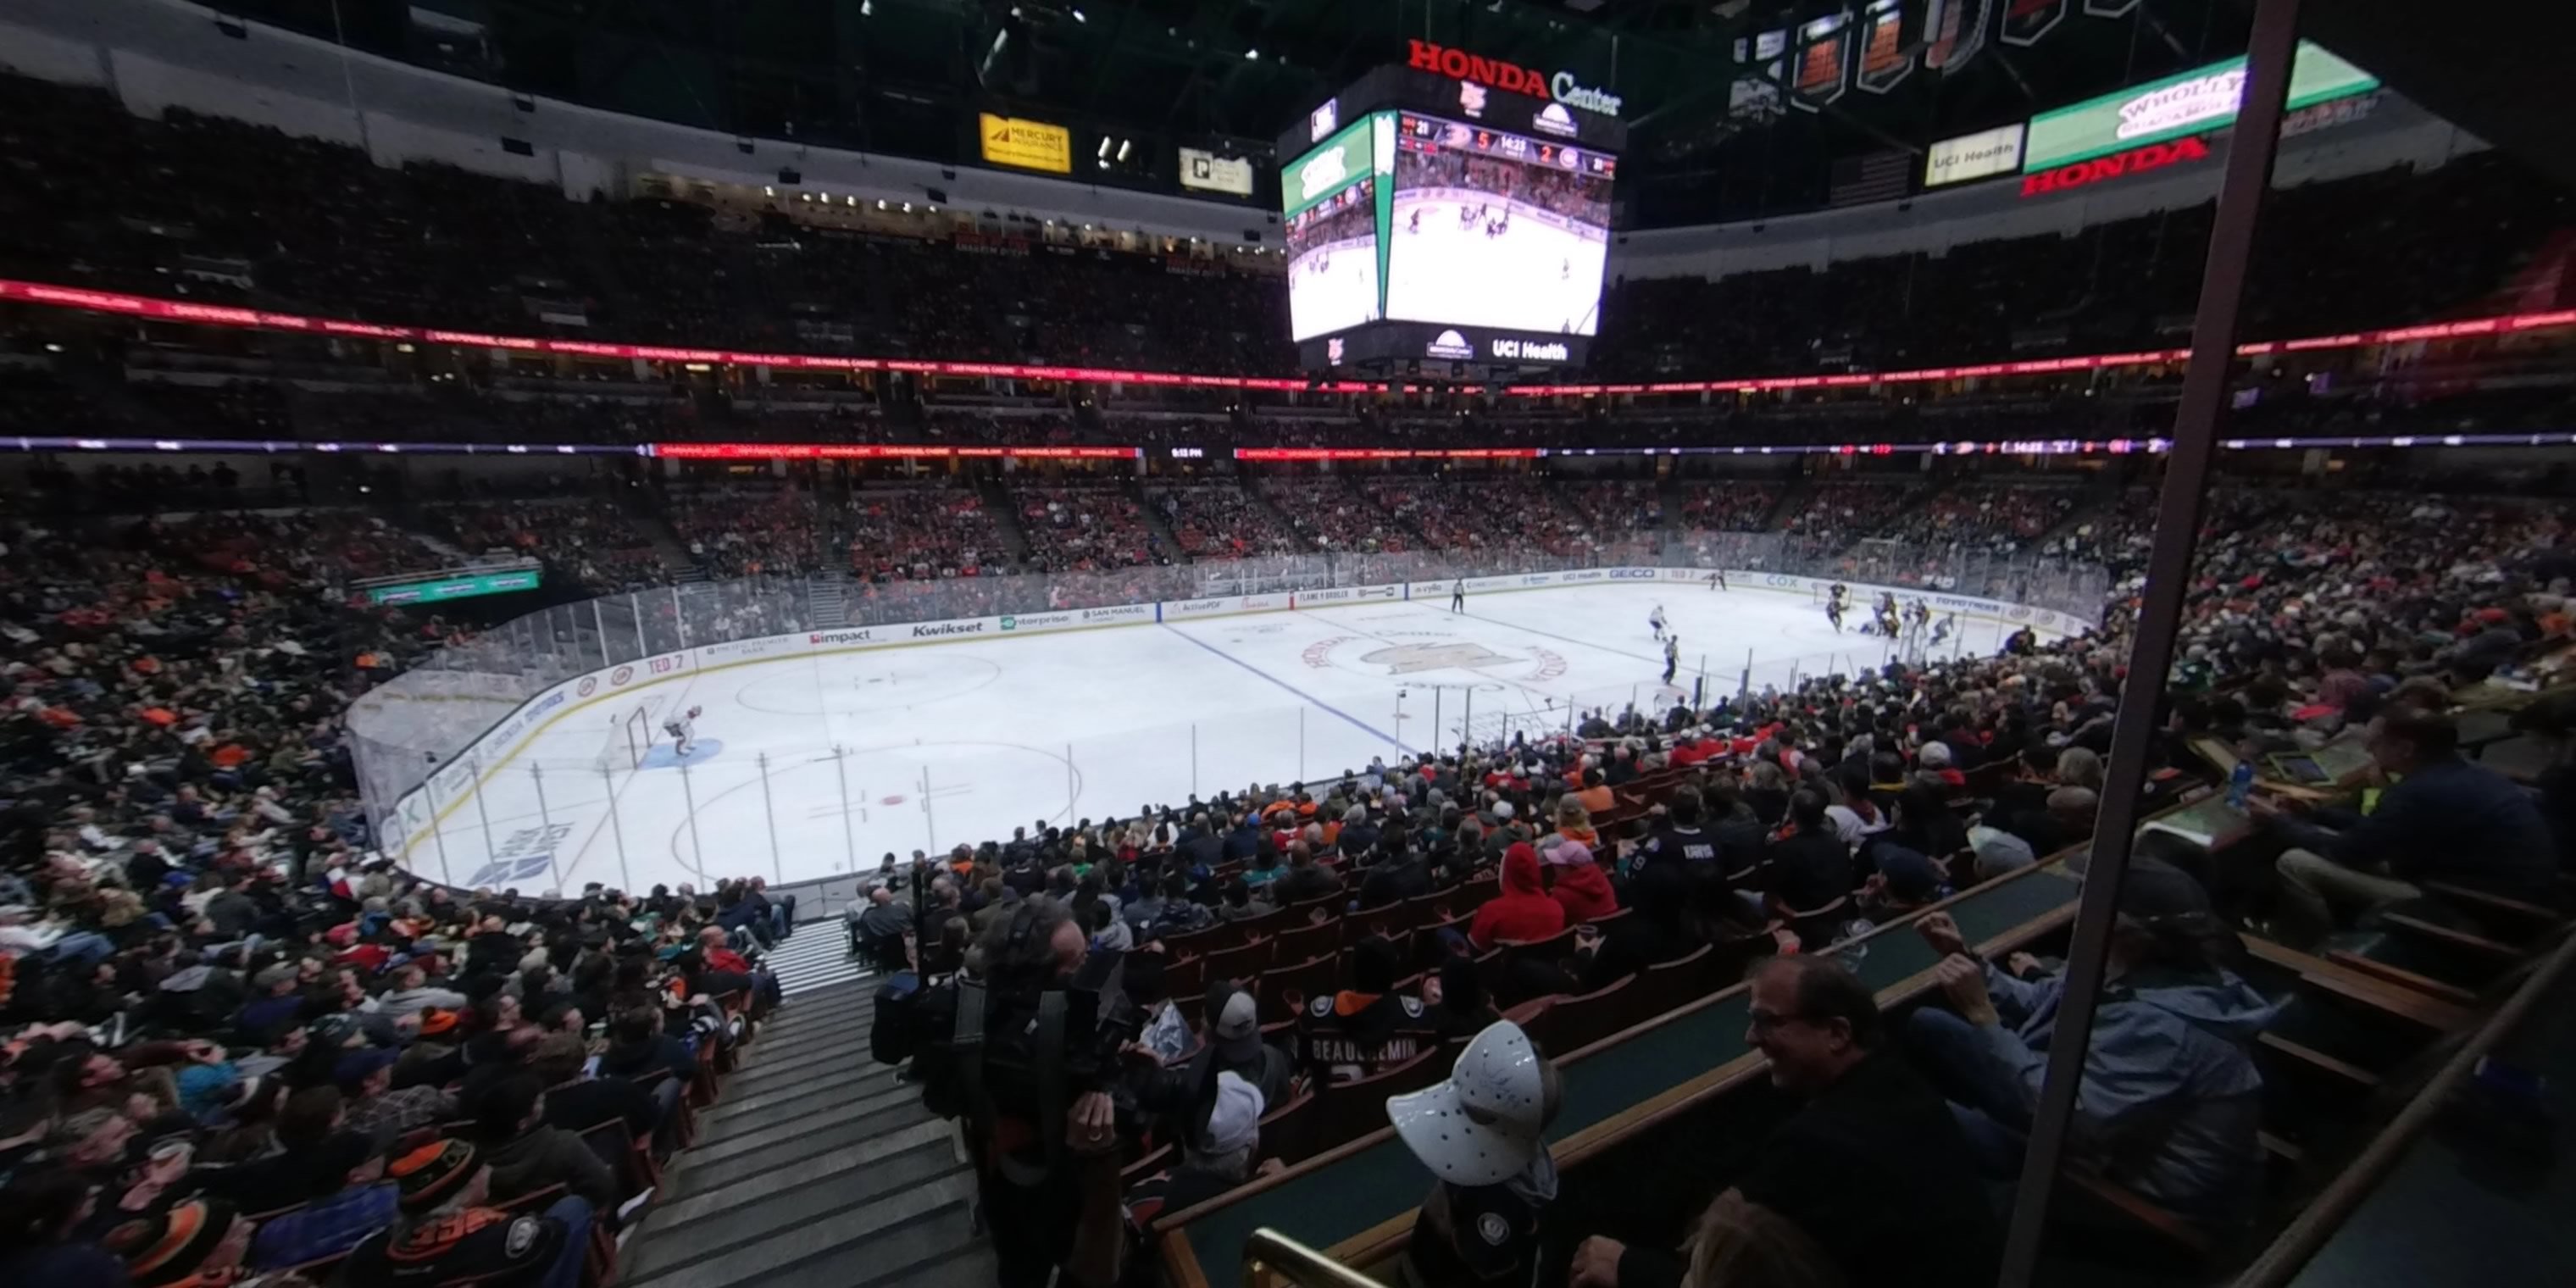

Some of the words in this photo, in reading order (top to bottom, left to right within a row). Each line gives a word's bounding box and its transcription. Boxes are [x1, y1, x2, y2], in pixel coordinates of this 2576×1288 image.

[1407, 40, 1549, 97] HONDA
[1552, 72, 1622, 116] Center
[1011, 126, 1063, 142] MERCURY
[1478, 131, 1489, 150] 5
[1541, 145, 1551, 163] 2
[1934, 153, 1960, 169] UCI
[1963, 143, 2014, 164] Health
[2020, 137, 2208, 197] HONDA
[1493, 339, 1519, 358] UCI
[1522, 340, 1568, 361] Health
[1189, 448, 1202, 458] PM
[1563, 573, 1576, 581] UCI
[1609, 569, 1655, 578] GEICO
[1766, 575, 1797, 588] COX
[1091, 608, 1109, 617] SAN
[1110, 606, 1146, 615] MANUEL
[1182, 601, 1221, 611] ActivePDF
[820, 630, 871, 644] impact
[912, 621, 984, 637] Kwikset
[647, 657, 672, 675] TED
[675, 654, 684, 669] 7
